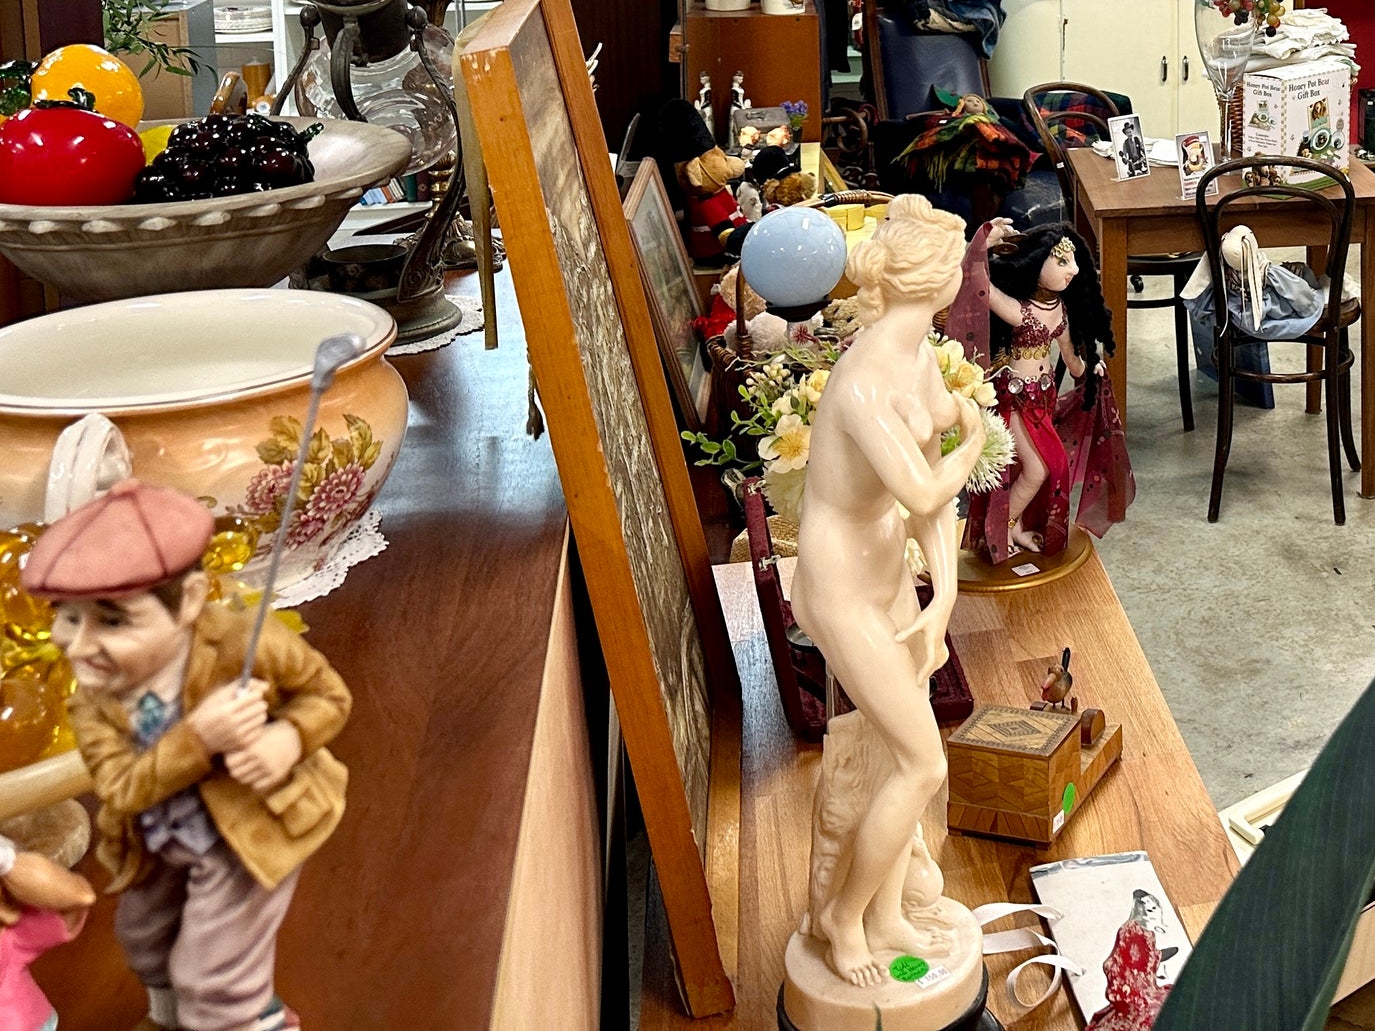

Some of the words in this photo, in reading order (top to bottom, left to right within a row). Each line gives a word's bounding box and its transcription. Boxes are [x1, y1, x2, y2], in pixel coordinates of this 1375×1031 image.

[1246, 81, 1261, 89] Honey
[1269, 84, 1281, 92] Bear
[1288, 83, 1306, 92] Honey
[1307, 80, 1317, 89] Pot
[1317, 78, 1330, 87] Bear
[1253, 89, 1263, 97] Gift
[1263, 90, 1273, 98] Box
[1297, 91, 1309, 100] Gift
[1310, 89, 1321, 97] Box
